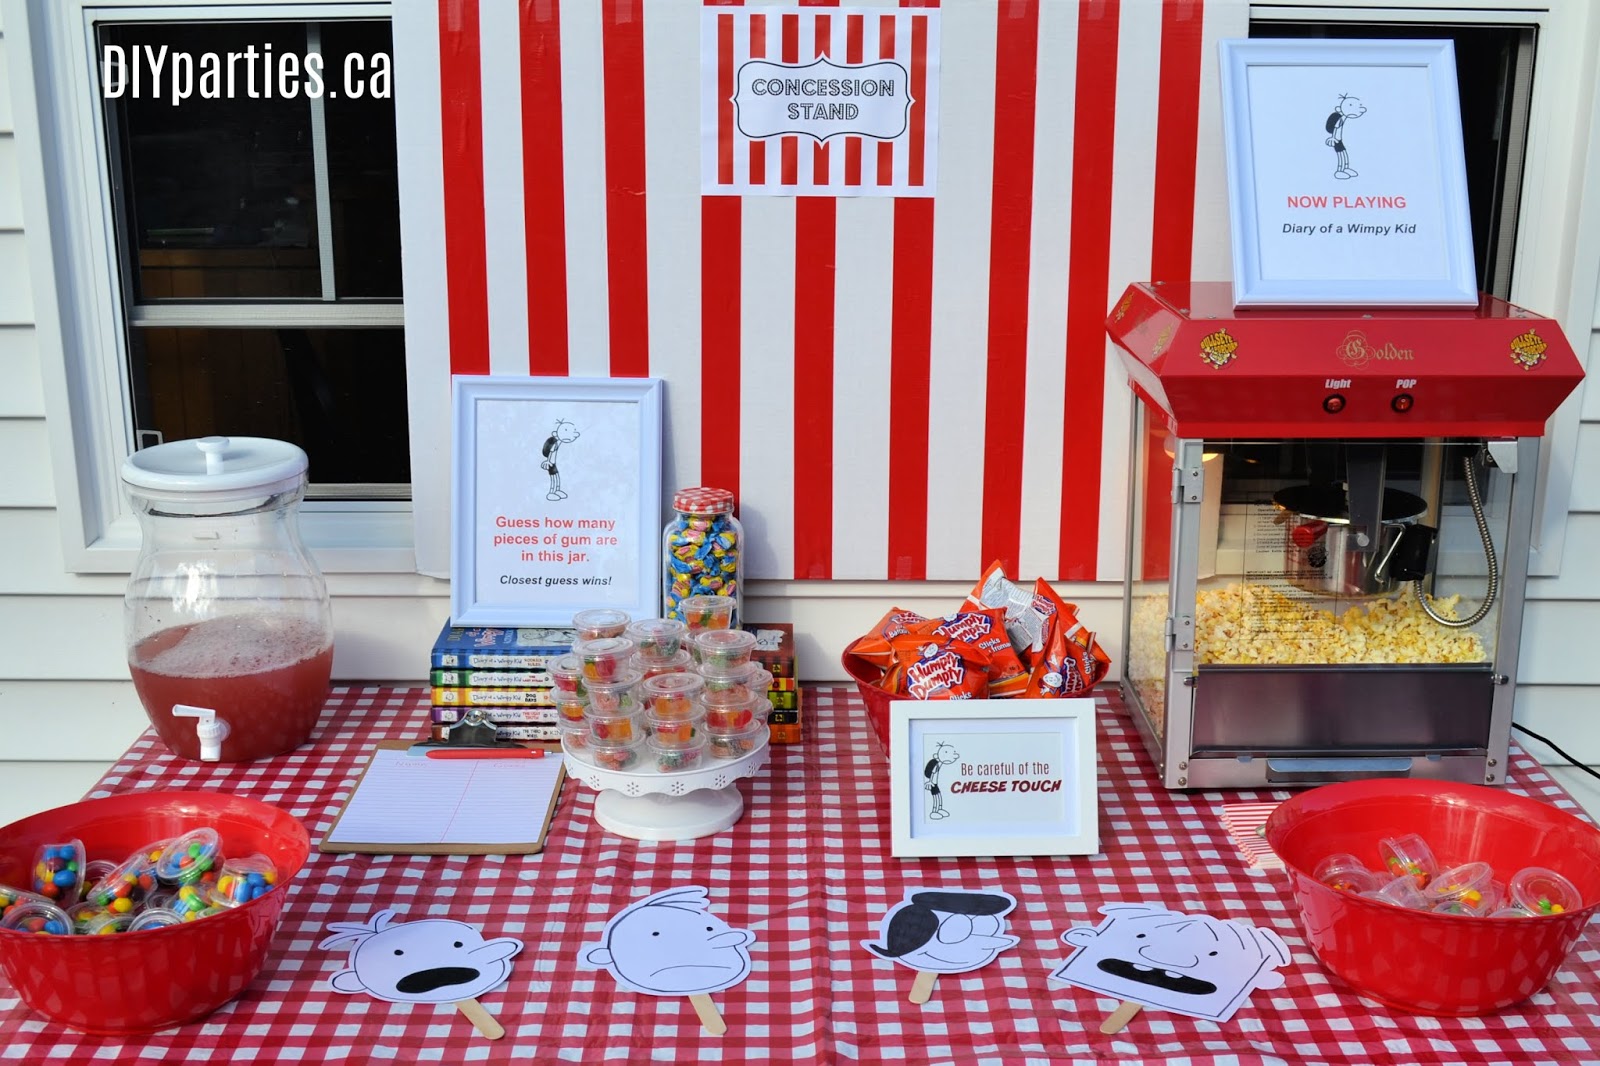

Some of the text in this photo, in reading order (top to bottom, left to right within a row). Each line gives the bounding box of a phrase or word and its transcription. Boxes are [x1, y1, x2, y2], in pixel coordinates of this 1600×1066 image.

[752, 78, 895, 97] CONCESSION
[787, 103, 859, 120] STAND
[1287, 195, 1407, 209] NOW PLAYING
[1282, 223, 1417, 236] Diary of a Wimpy Kid
[1340, 334, 1414, 364] Golden
[1325, 379, 1351, 389] Light
[1396, 379, 1417, 388] POP
[495, 516, 615, 531] Guess how many
[494, 533, 618, 547] pieces of gum are
[521, 550, 590, 564] in this jar.
[500, 575, 612, 587] Closest guess wins!
[956, 624, 990, 642] mpty
[979, 638, 1001, 650] Sticks
[907, 652, 961, 684] Humpty
[908, 667, 963, 700] Dumpty
[961, 762, 1050, 776] Be careful of the
[950, 779, 1062, 794] CHEESE TOUCH
